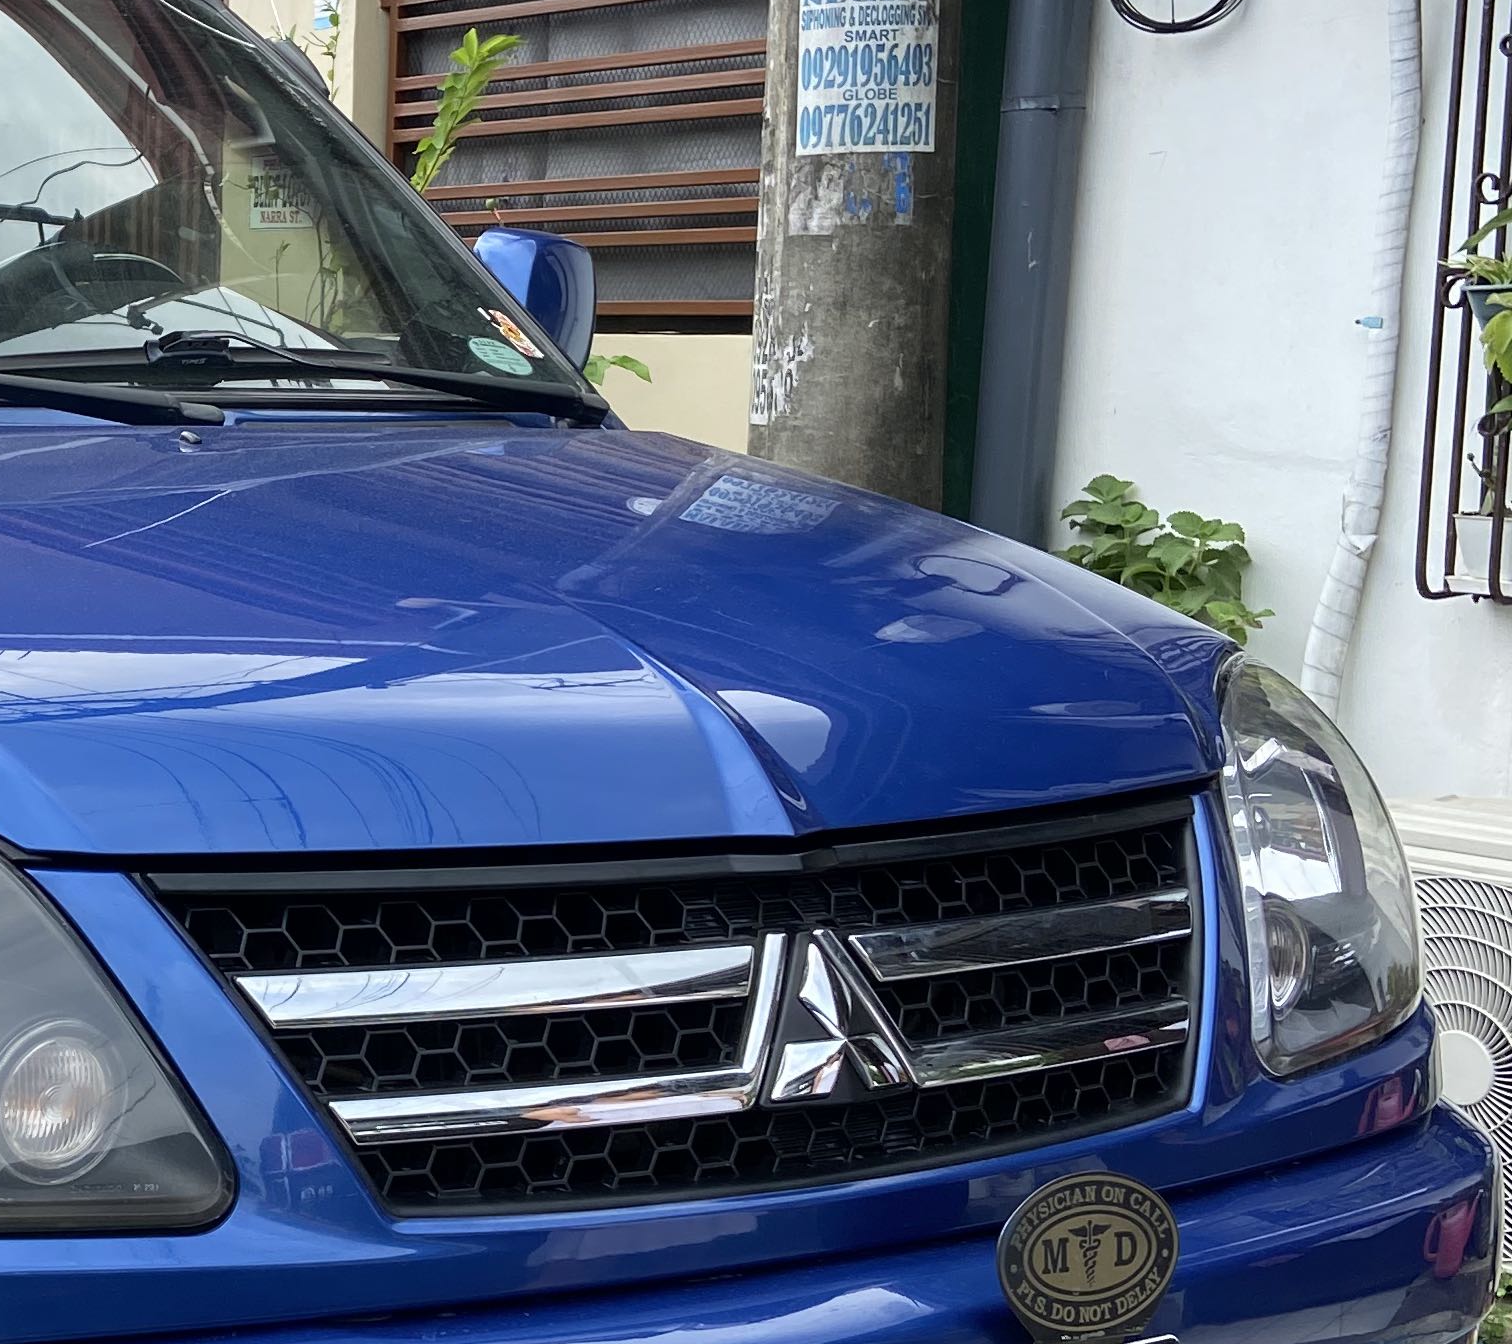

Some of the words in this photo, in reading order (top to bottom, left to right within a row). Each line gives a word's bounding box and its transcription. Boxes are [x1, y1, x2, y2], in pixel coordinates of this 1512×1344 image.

[801, 6, 847, 31] SIPHONING
[857, 3, 916, 27] DECLOGGING
[844, 28, 900, 43] SMART
[800, 42, 933, 91] 09291956493
[842, 87, 898, 101] GLOBE
[799, 102, 931, 150] 09776241251
[1010, 1185, 1097, 1252] PHYSICIAN
[1101, 1185, 1126, 1204] ON
[1129, 1192, 1170, 1239] CALL
[1041, 1237, 1070, 1275] M
[1114, 1231, 1137, 1267] D
[1050, 1302, 1076, 1323] DO
[1079, 1301, 1113, 1324] NOT
[1116, 1266, 1162, 1315] DELAY
